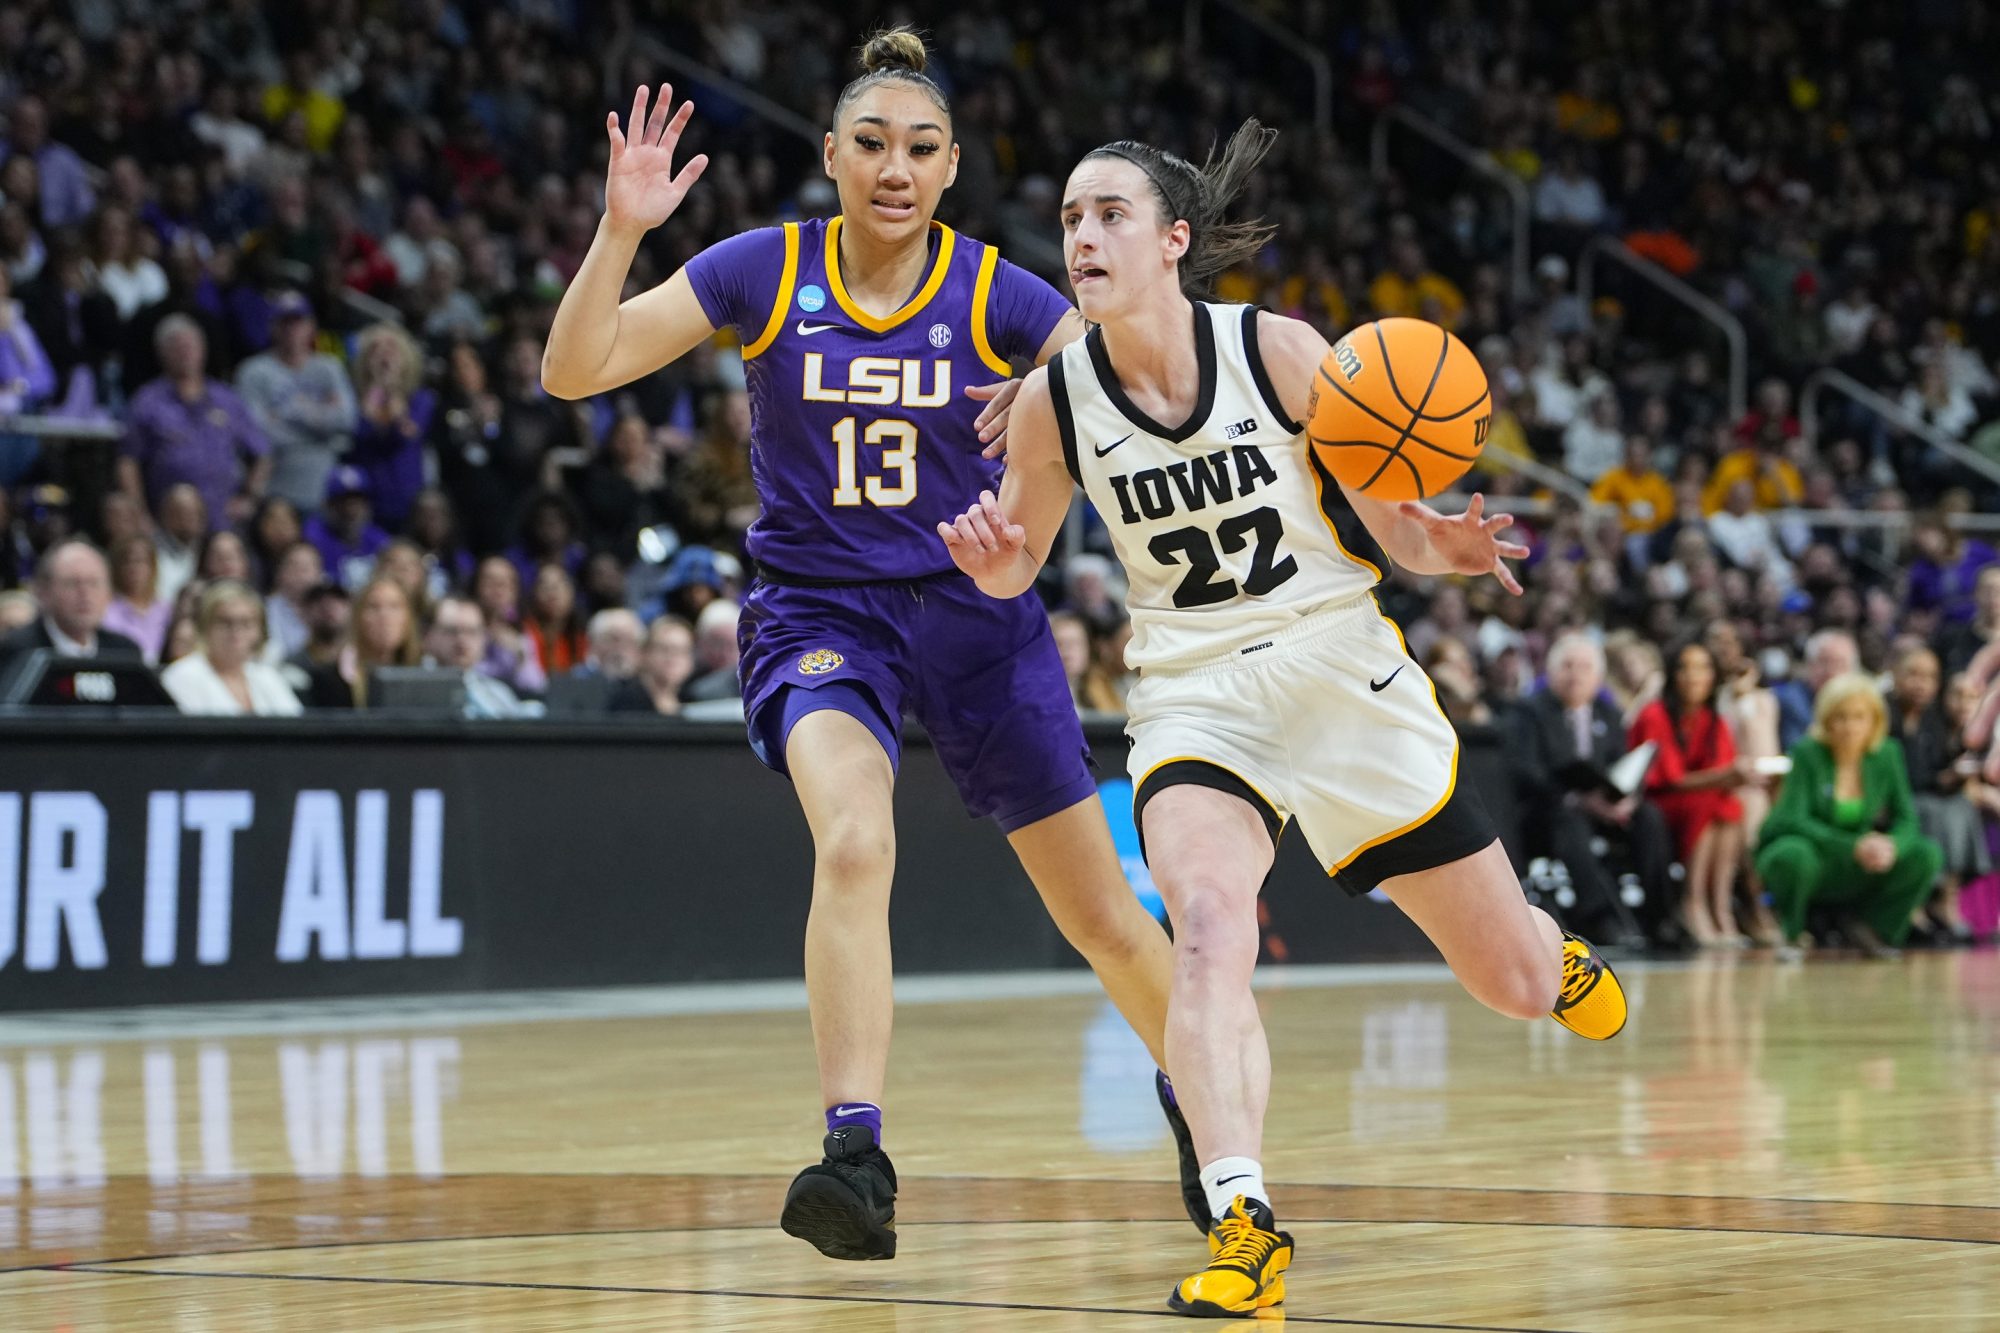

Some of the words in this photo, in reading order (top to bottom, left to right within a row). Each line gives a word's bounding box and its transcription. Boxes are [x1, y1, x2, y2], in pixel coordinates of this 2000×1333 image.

[801, 296, 823, 308] NCAA
[931, 325, 951, 347] SEC
[803, 353, 951, 407] LSU
[832, 417, 918, 507] 13
[1109, 445, 1278, 524] IOWA
[1147, 506, 1299, 608] 22
[142, 791, 255, 967] IT
[275, 789, 464, 962] ALL
